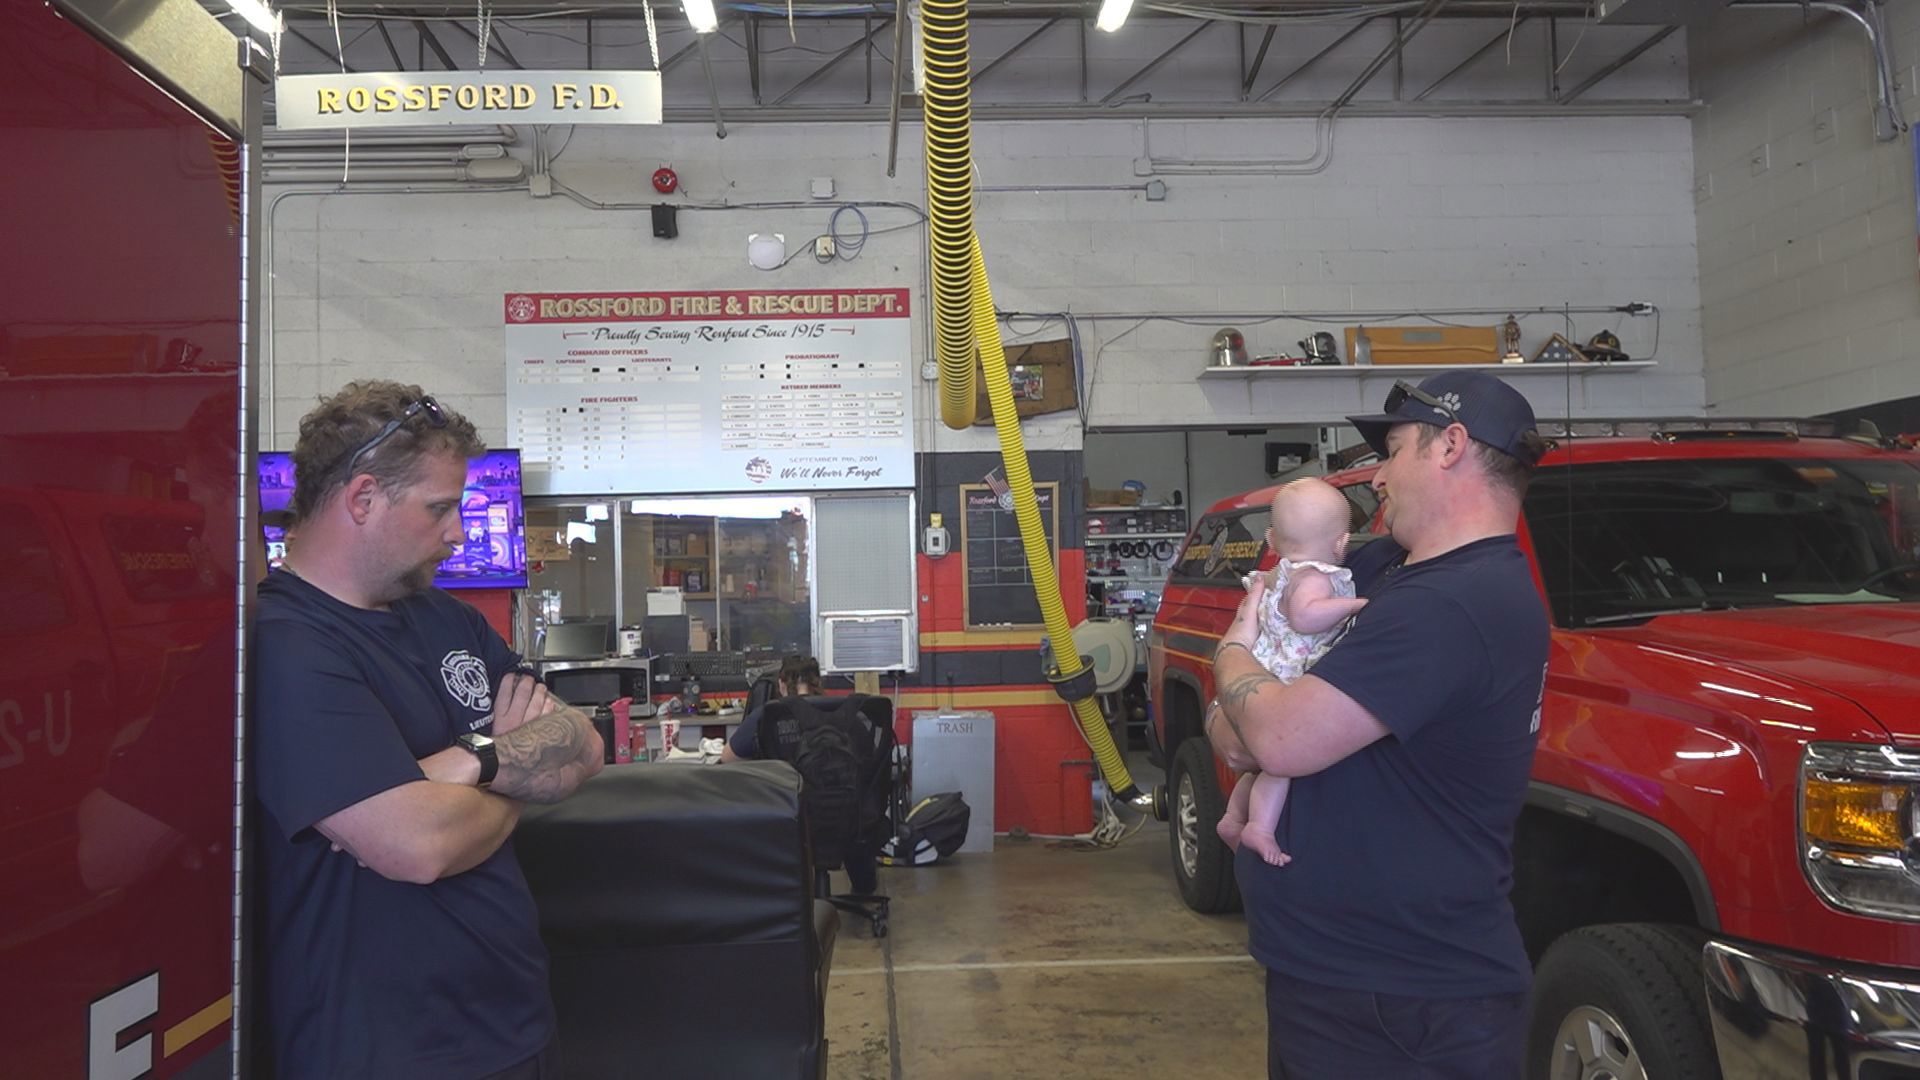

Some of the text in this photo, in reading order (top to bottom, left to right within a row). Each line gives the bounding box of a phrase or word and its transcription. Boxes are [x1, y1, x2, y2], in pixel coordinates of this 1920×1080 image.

[318, 83, 624, 114] ROSSFORD F.D.
[540, 293, 904, 318] ROSSFORD FIRE & RESCUE DEPT.
[592, 323, 826, 345] Proudly Serving Rossford Since 1915
[780, 467, 811, 479] We'll
[811, 466, 843, 479] Never
[845, 465, 883, 481] Forget
[936, 722, 974, 733] TRASH
